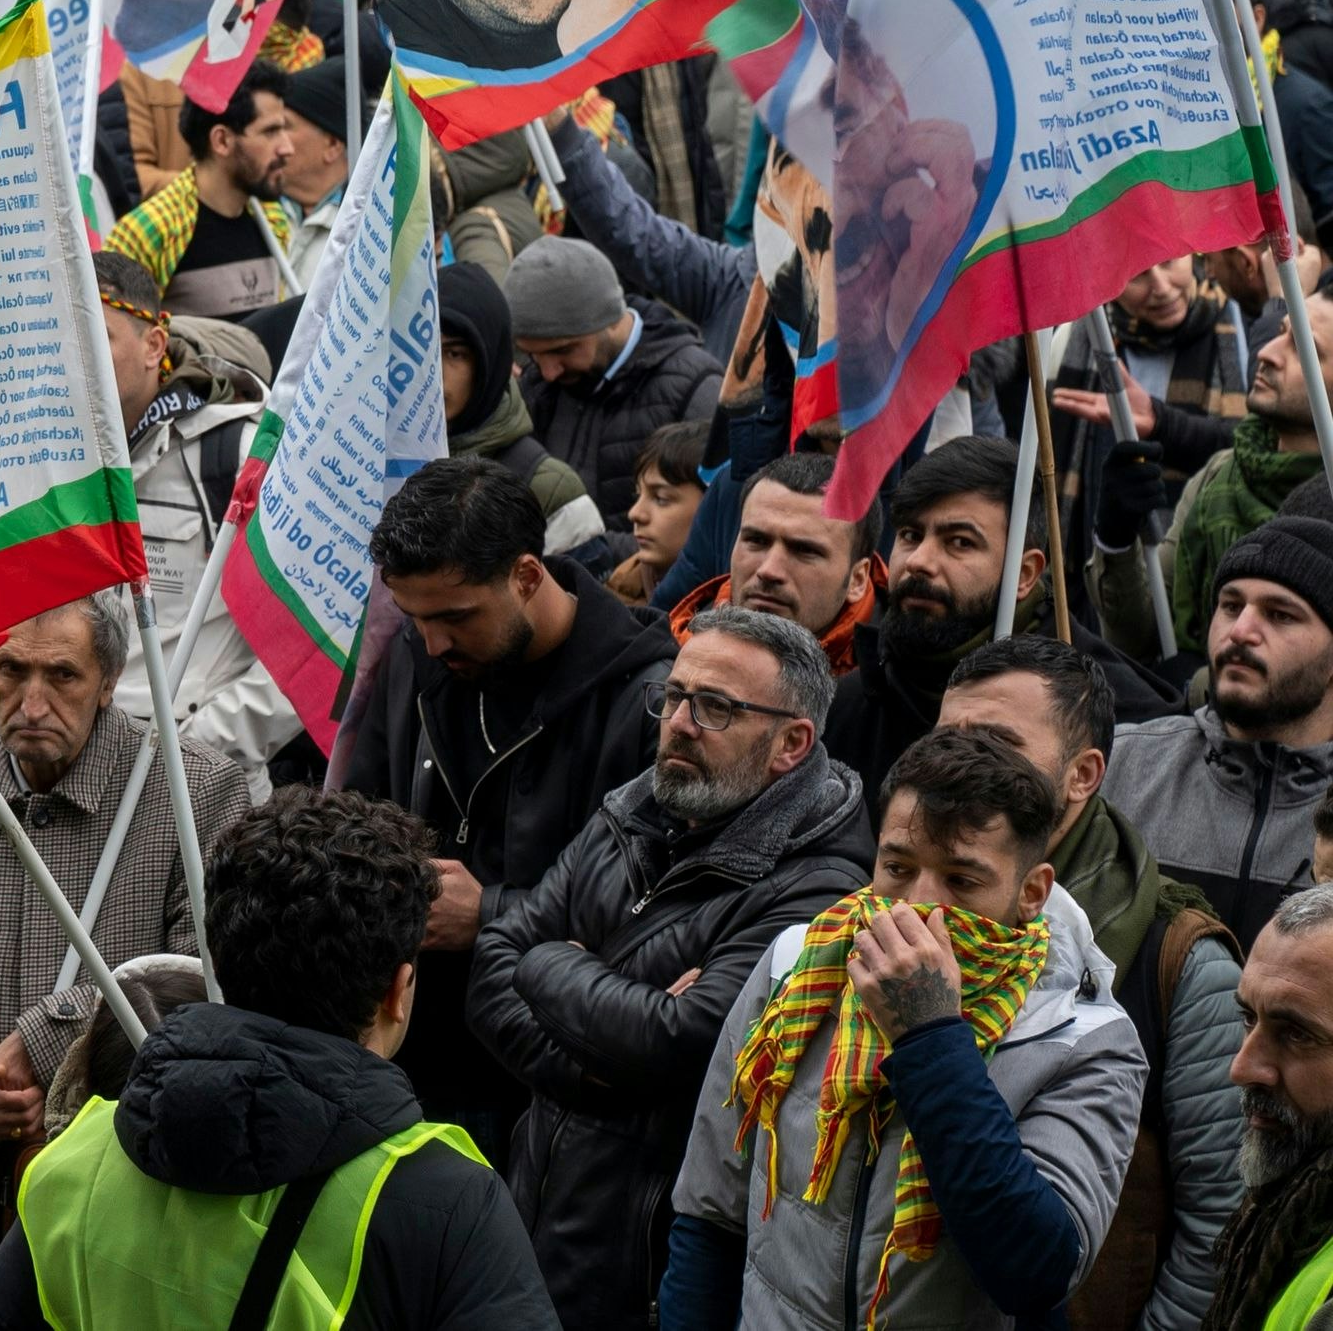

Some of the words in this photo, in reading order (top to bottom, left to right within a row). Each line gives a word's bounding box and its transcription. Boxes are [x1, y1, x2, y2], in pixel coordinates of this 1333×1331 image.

[349, 413, 371, 441] Frihet
[272, 504, 294, 532] ji
[286, 516, 313, 552] bo
[163, 568, 185, 579] WAY
